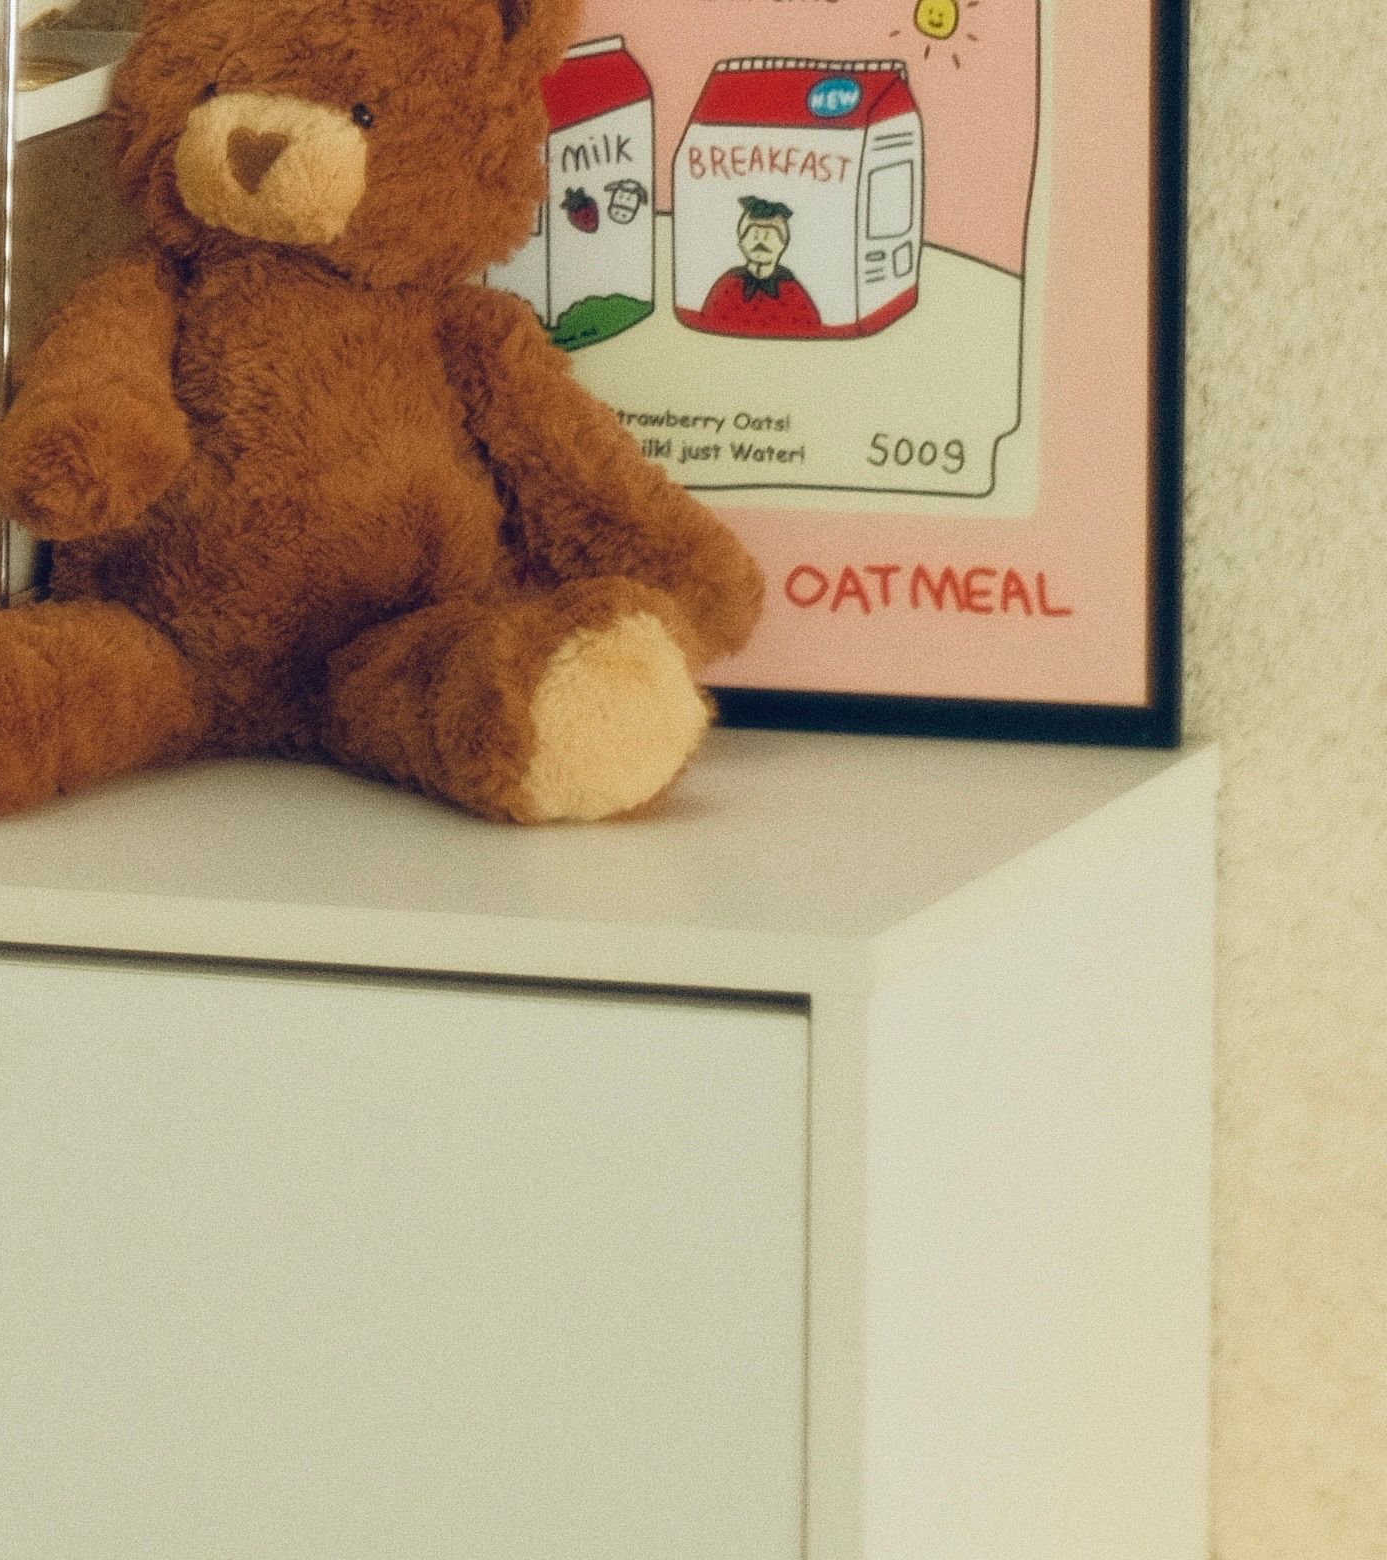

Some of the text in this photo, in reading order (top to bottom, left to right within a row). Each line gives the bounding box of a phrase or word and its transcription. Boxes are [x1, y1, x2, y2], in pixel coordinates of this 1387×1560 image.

[809, 89, 862, 110] NEW
[687, 144, 852, 183] BREAKFAST
[613, 408, 792, 434] trawberry Oats!
[640, 438, 807, 465] ilk! just Water!
[867, 431, 967, 475] 500g
[783, 563, 1073, 618] OATMEAL
